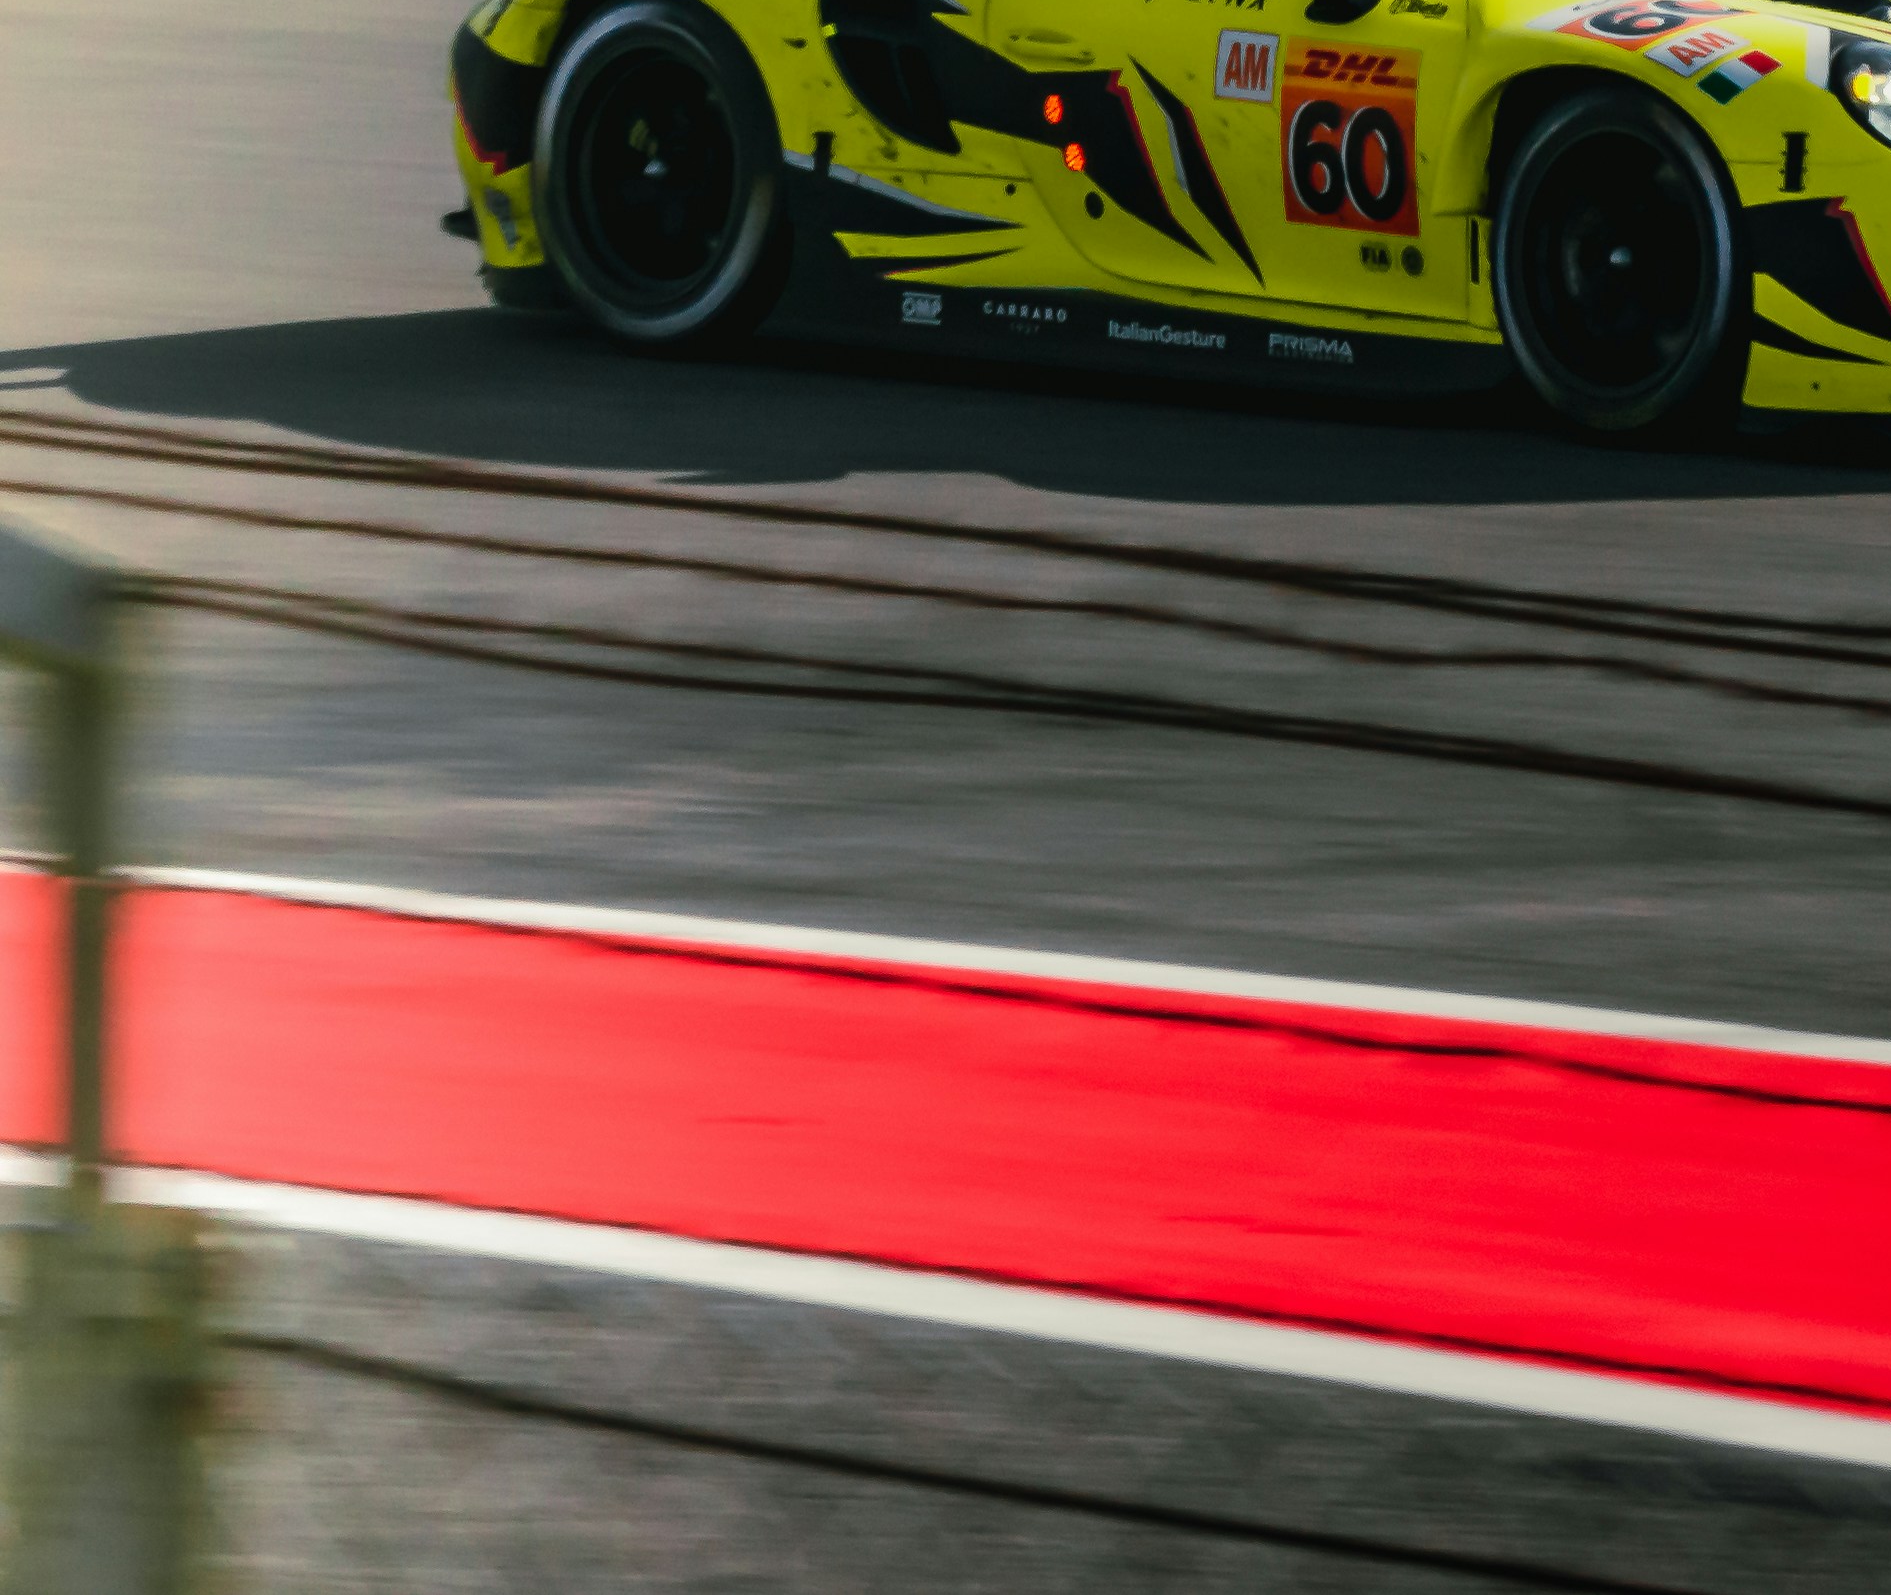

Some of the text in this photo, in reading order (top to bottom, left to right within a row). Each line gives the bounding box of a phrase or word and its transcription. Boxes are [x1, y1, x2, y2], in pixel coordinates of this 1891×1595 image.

[1223, 41, 1270, 92] AM
[1302, 49, 1400, 87] DHL
[1668, 32, 1734, 67] AM
[1288, 99, 1407, 222] 60
[1269, 333, 1353, 356] PRISMA
